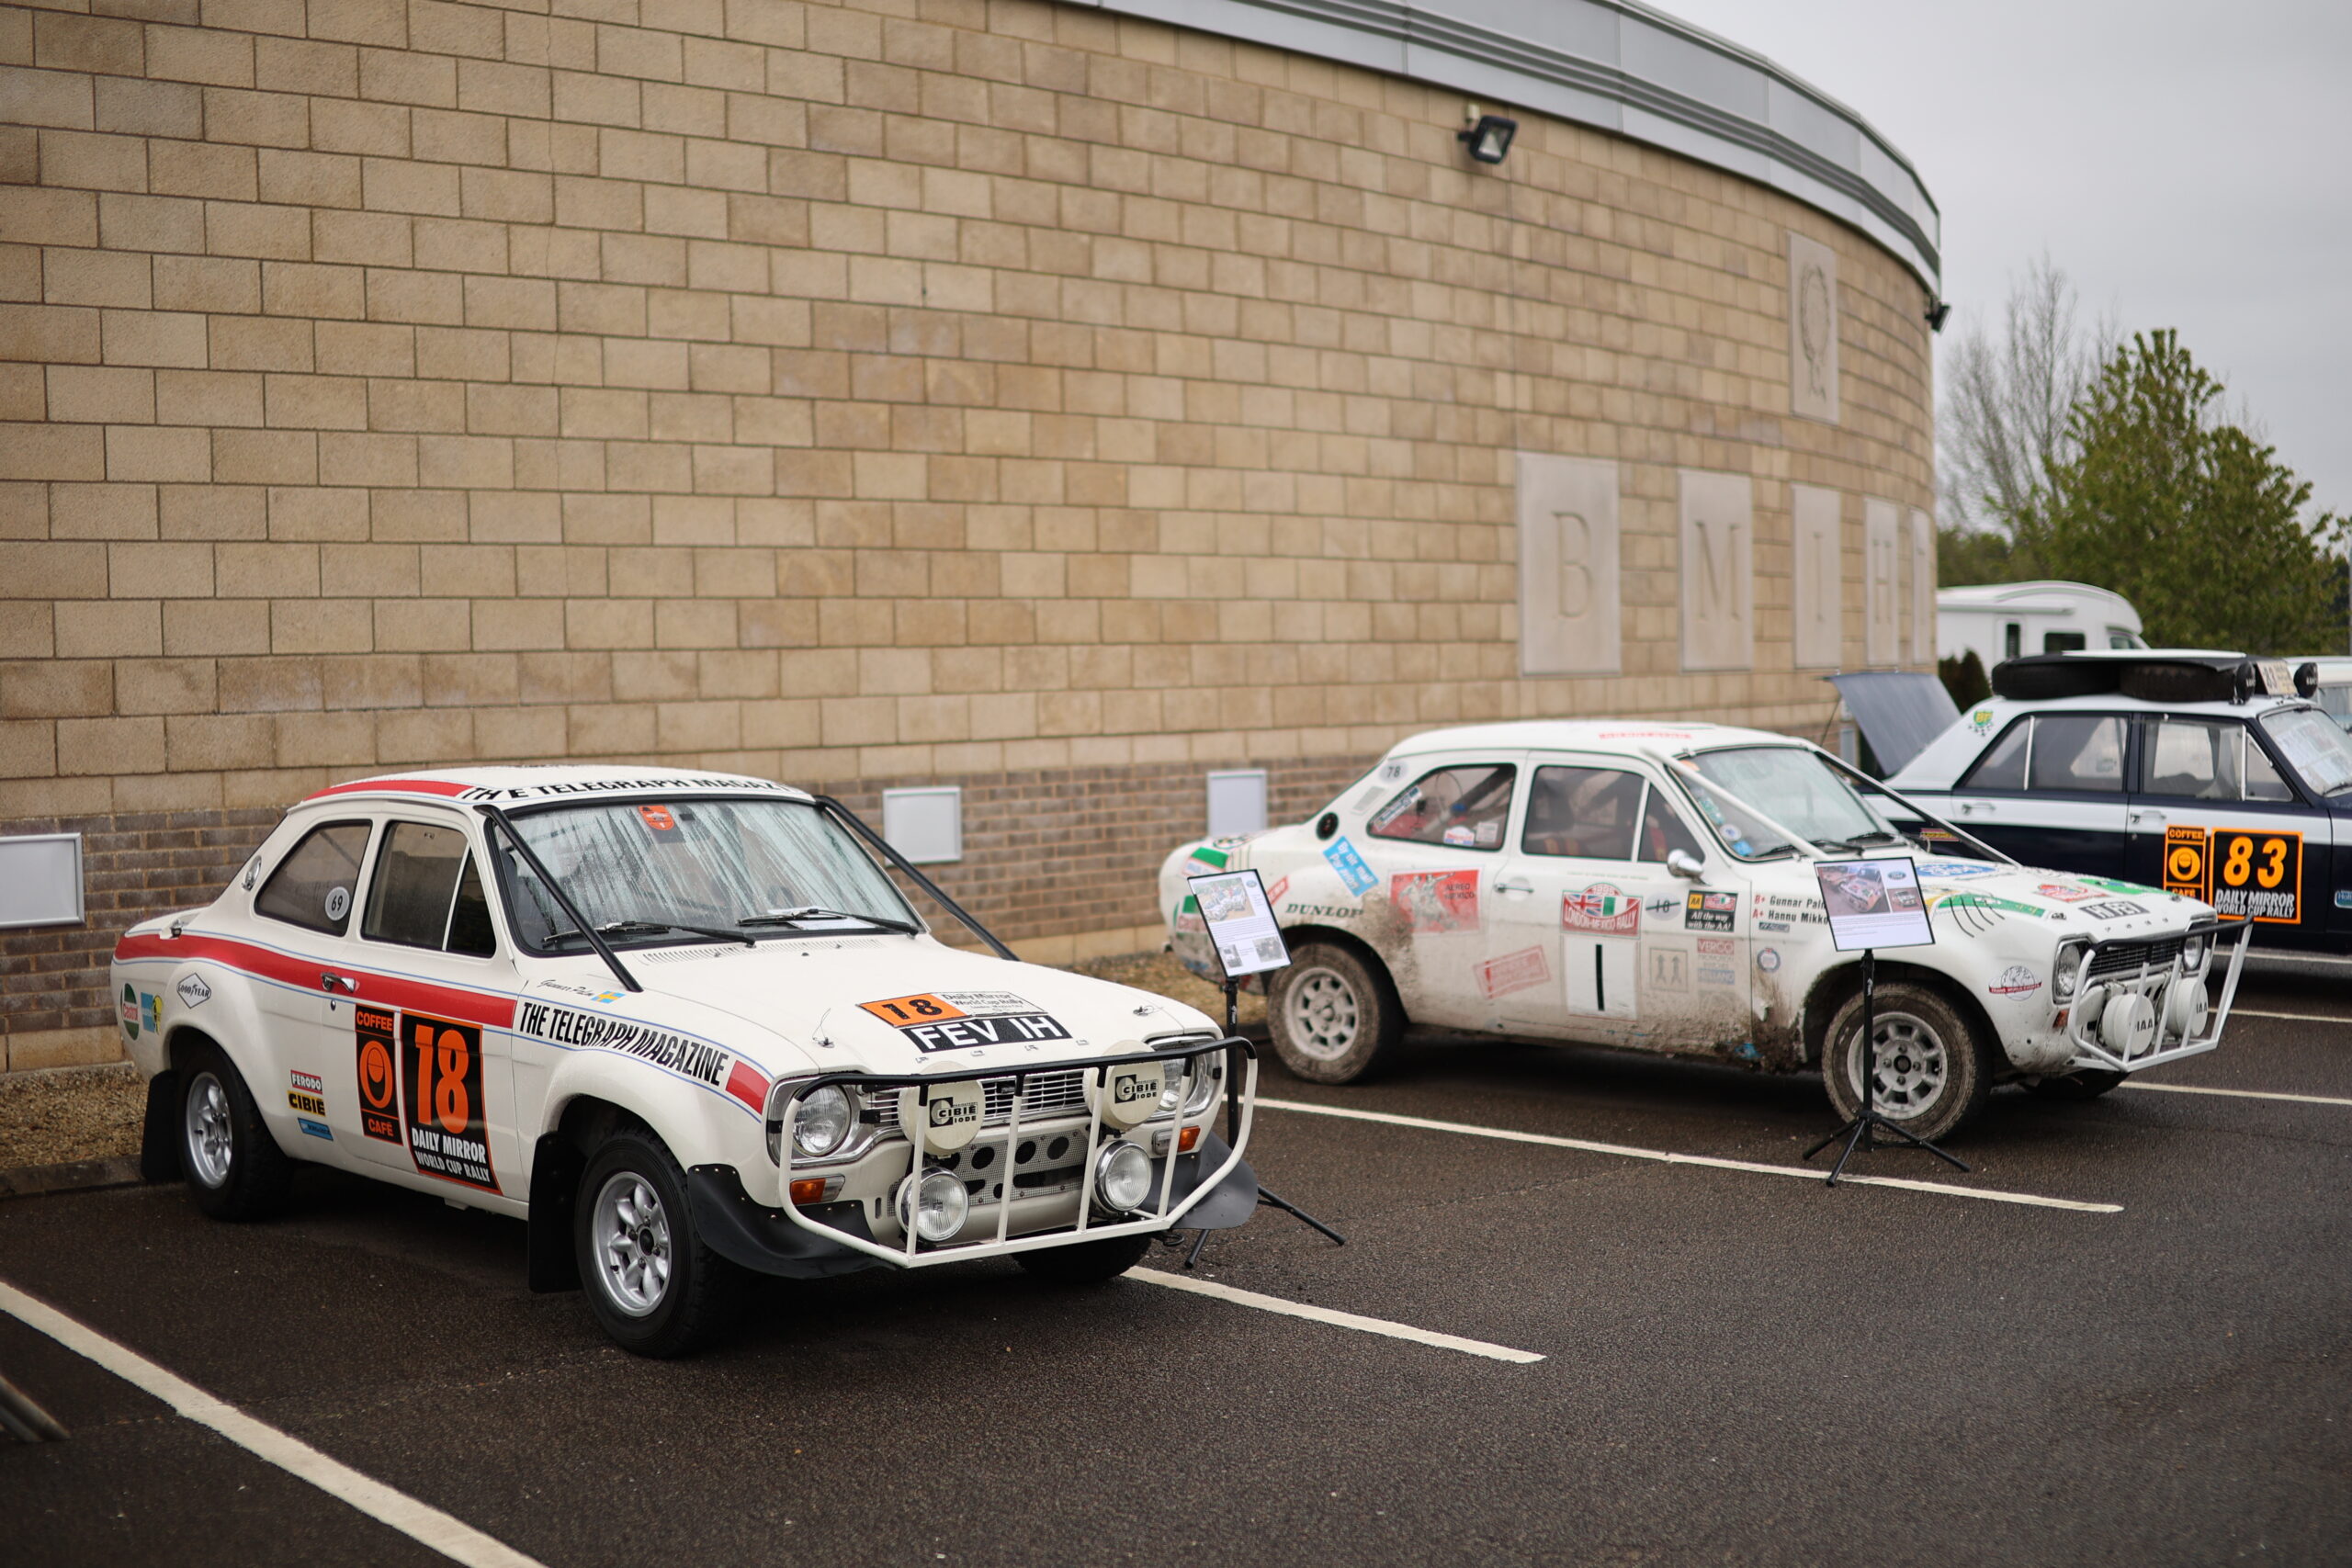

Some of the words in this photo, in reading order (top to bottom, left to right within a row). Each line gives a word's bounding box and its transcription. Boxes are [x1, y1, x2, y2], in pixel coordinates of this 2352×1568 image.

[1553, 511, 1592, 620] B
[1694, 519, 1742, 622] M
[1387, 765, 1401, 778] 78
[461, 787, 529, 801] THE
[531, 780, 691, 795] TELEGRAPH
[2168, 829, 2203, 840] COFFEE
[2223, 836, 2288, 889] 83
[331, 895, 344, 911] 69
[1770, 896, 1803, 908] Gunnar
[2214, 888, 2247, 905] DAILY
[2249, 890, 2295, 908] MIRROR
[1285, 904, 1364, 919] DUNLOP
[1769, 910, 1797, 921] Hannu
[1801, 912, 1828, 925] Mikko
[2214, 902, 2246, 916] WORLD
[2247, 904, 2267, 917] CUP
[2268, 906, 2295, 919] RALLY
[1704, 921, 1714, 930] the
[1595, 943, 1605, 1011] 1
[881, 998, 944, 1021] 18
[356, 1010, 393, 1032] COFFEE
[2131, 1019, 2154, 1032] IAA
[519, 1002, 548, 1037] THE
[548, 1008, 640, 1050] TELEGRAPH
[631, 1027, 729, 1087] MAGAZINE
[910, 1020, 1000, 1050] FEV
[291, 1073, 322, 1091] FERODO
[414, 1023, 469, 1134] 18
[1136, 1091, 1158, 1100] IODE
[954, 1115, 977, 1123] IODE
[411, 1127, 440, 1153] DAILY
[442, 1135, 487, 1165] MIRROR
[414, 1150, 446, 1171] WORLD
[446, 1158, 462, 1176] CUP
[465, 1164, 492, 1183] RALLY
